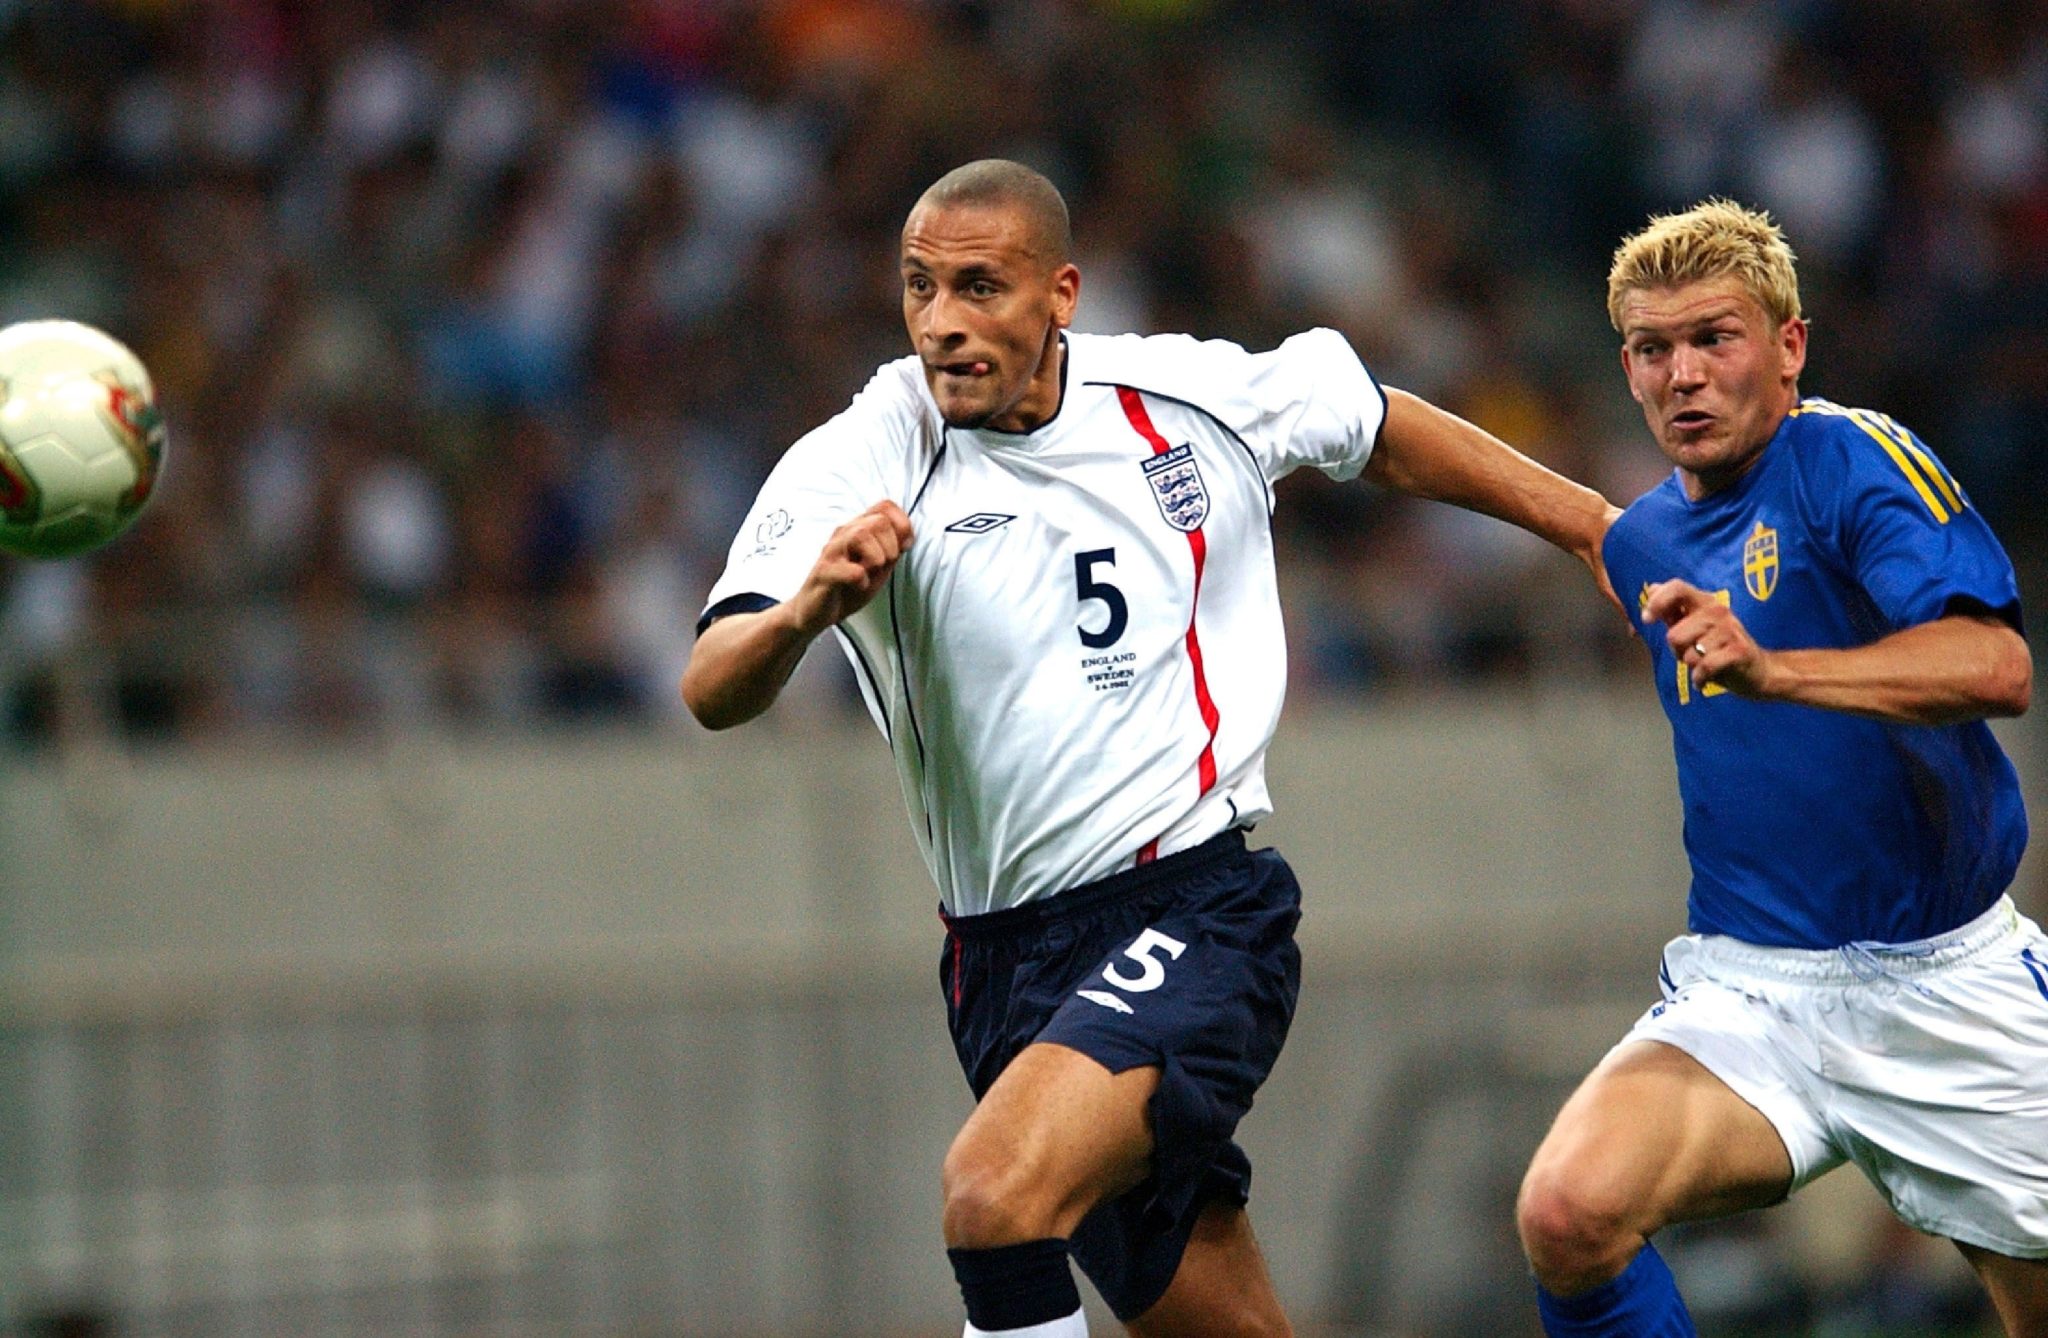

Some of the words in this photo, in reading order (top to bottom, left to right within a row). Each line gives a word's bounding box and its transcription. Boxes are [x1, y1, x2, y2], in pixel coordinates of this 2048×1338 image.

[1144, 446, 1188, 471] ENGLAND
[1075, 548, 1128, 649] 5
[1081, 652, 1137, 669] ENGLAND
[1087, 668, 1135, 684] SWEDEN
[1102, 928, 1187, 992] 5
